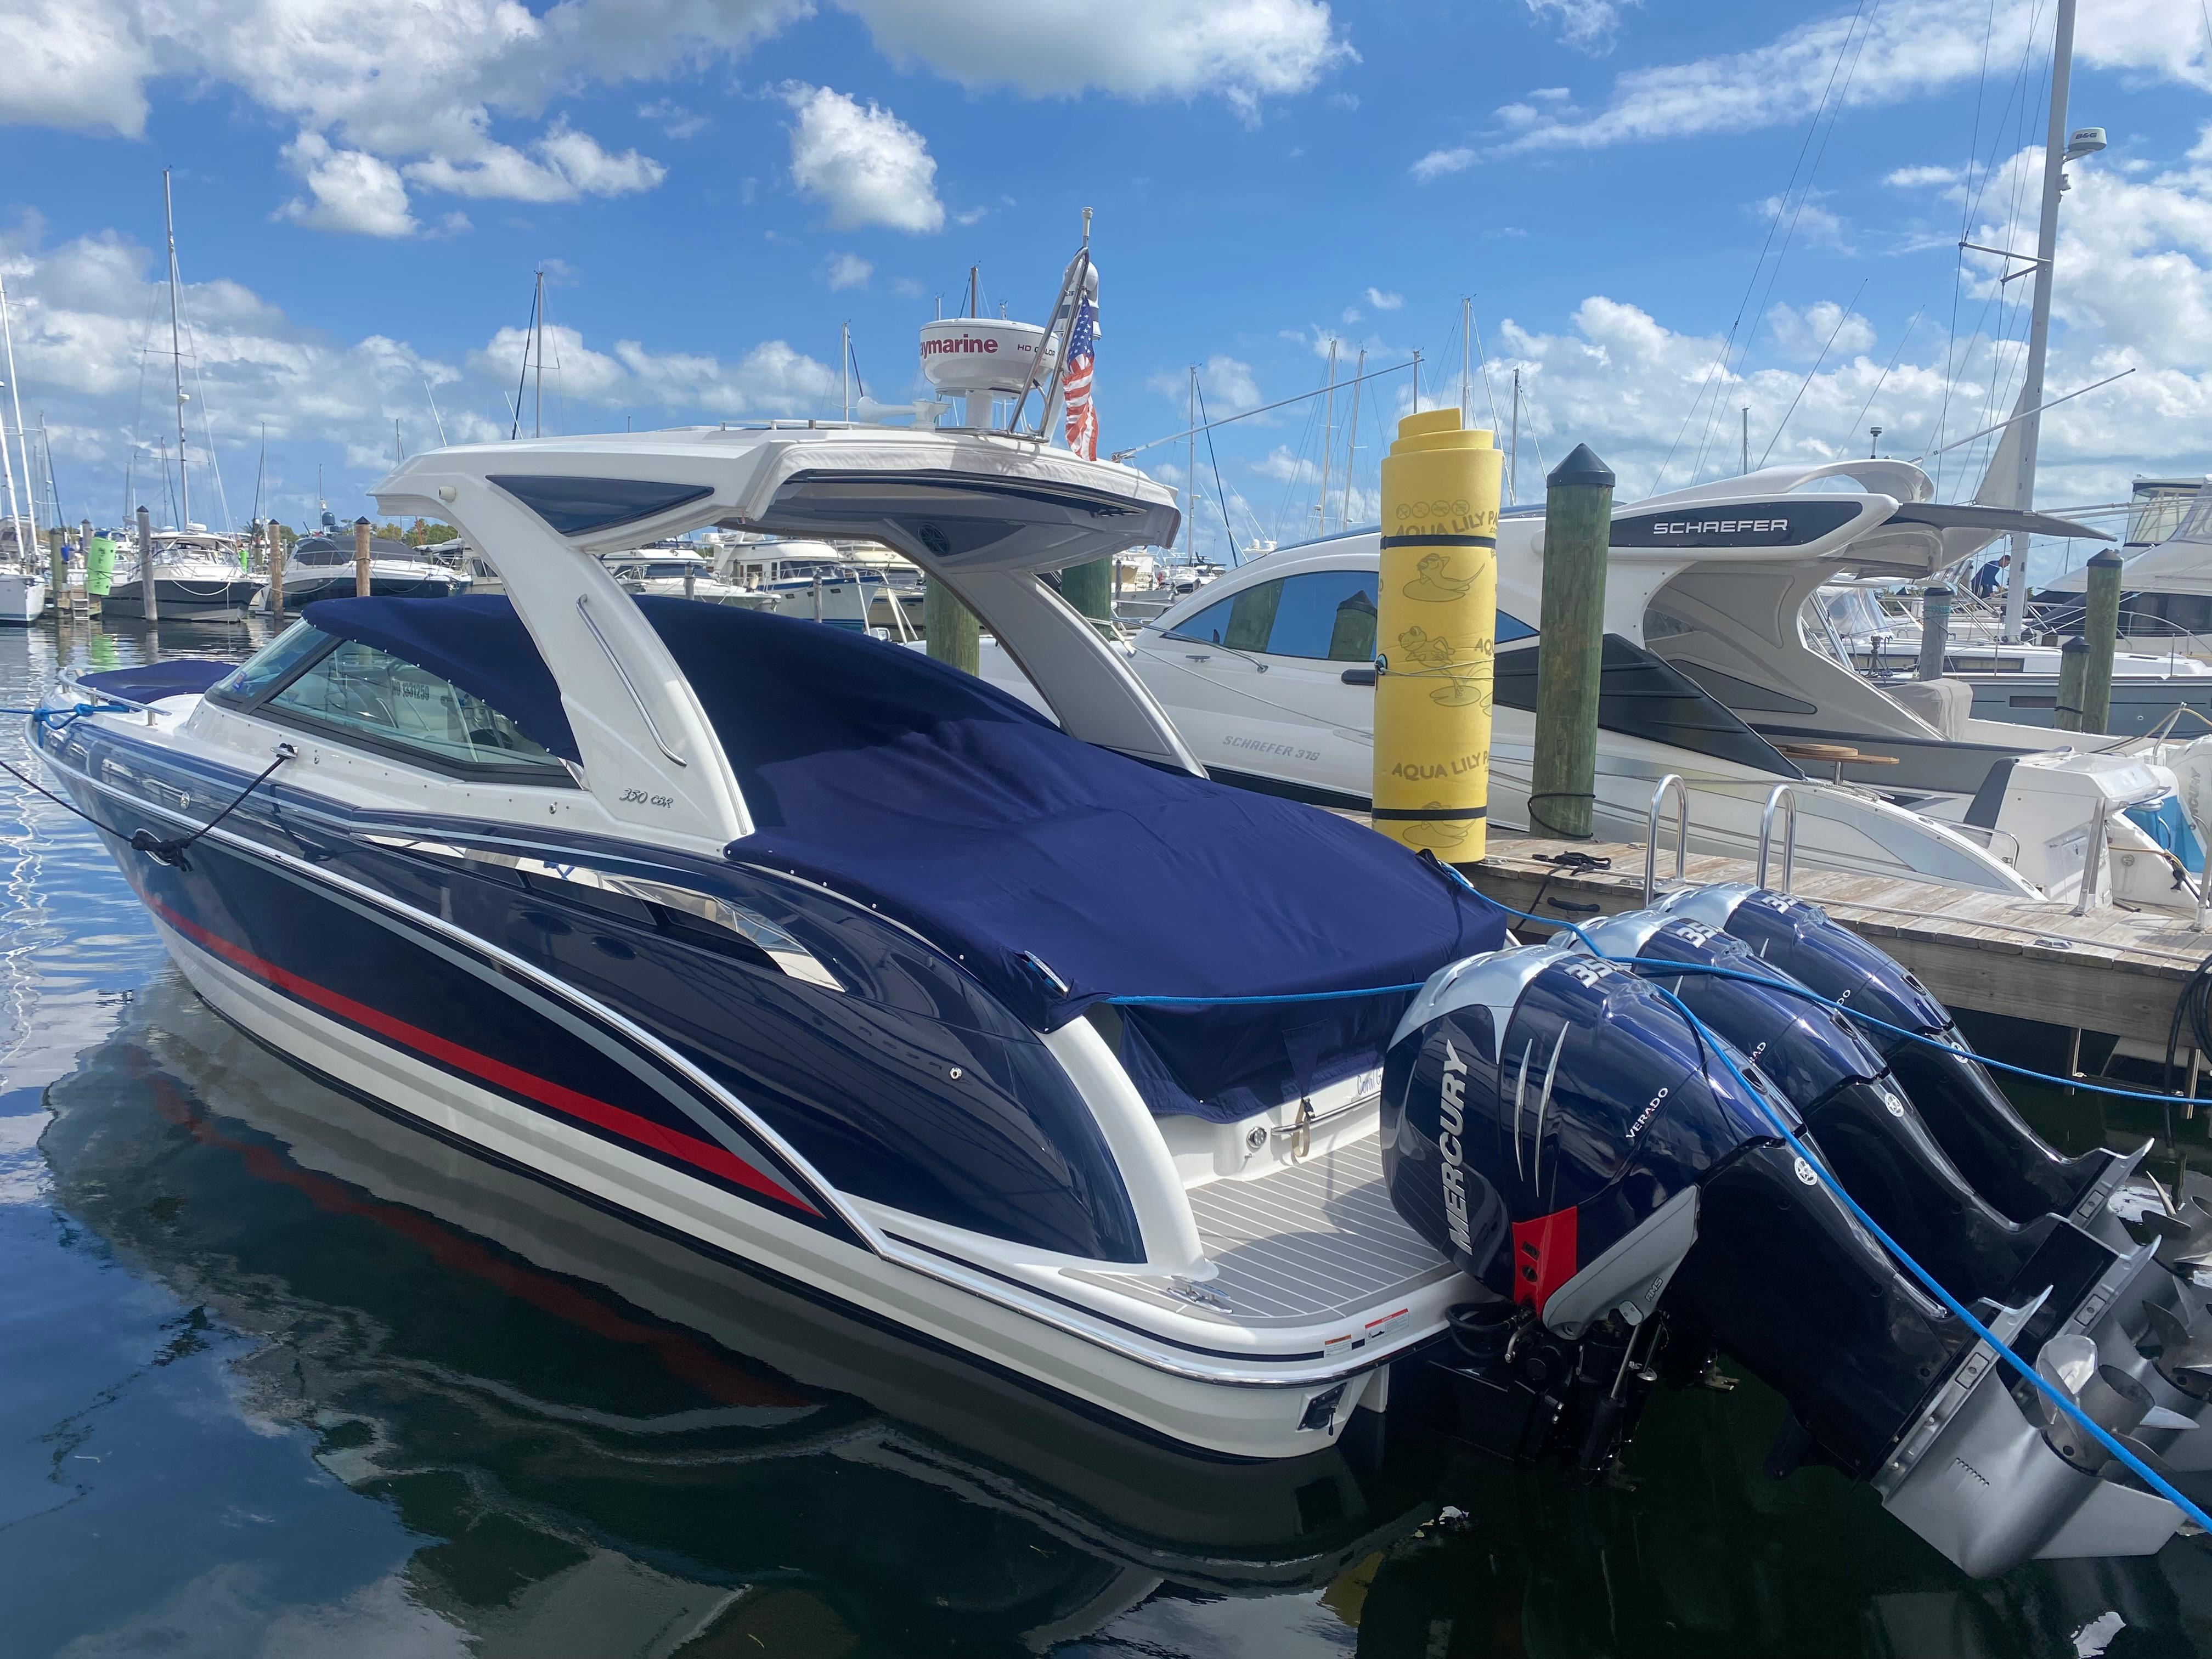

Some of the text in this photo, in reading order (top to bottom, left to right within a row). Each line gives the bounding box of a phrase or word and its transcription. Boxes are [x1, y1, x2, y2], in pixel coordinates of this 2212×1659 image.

[919, 334, 998, 359] aymarine
[1034, 346, 1055, 357] CLOR
[1452, 511, 1485, 533] LILY
[1488, 510, 1498, 527] PA
[1653, 519, 1788, 534] SCHAEFER
[1223, 736, 1294, 757] SCHAEFER
[1391, 762, 1448, 782] AQUA
[1451, 752, 1480, 775] LILY
[619, 788, 674, 809] 350 CBR
[1625, 1087, 1668, 1138] VERADO
[1439, 1038, 1473, 1256] MERCURY
[1645, 1277, 1663, 1302] AMS
